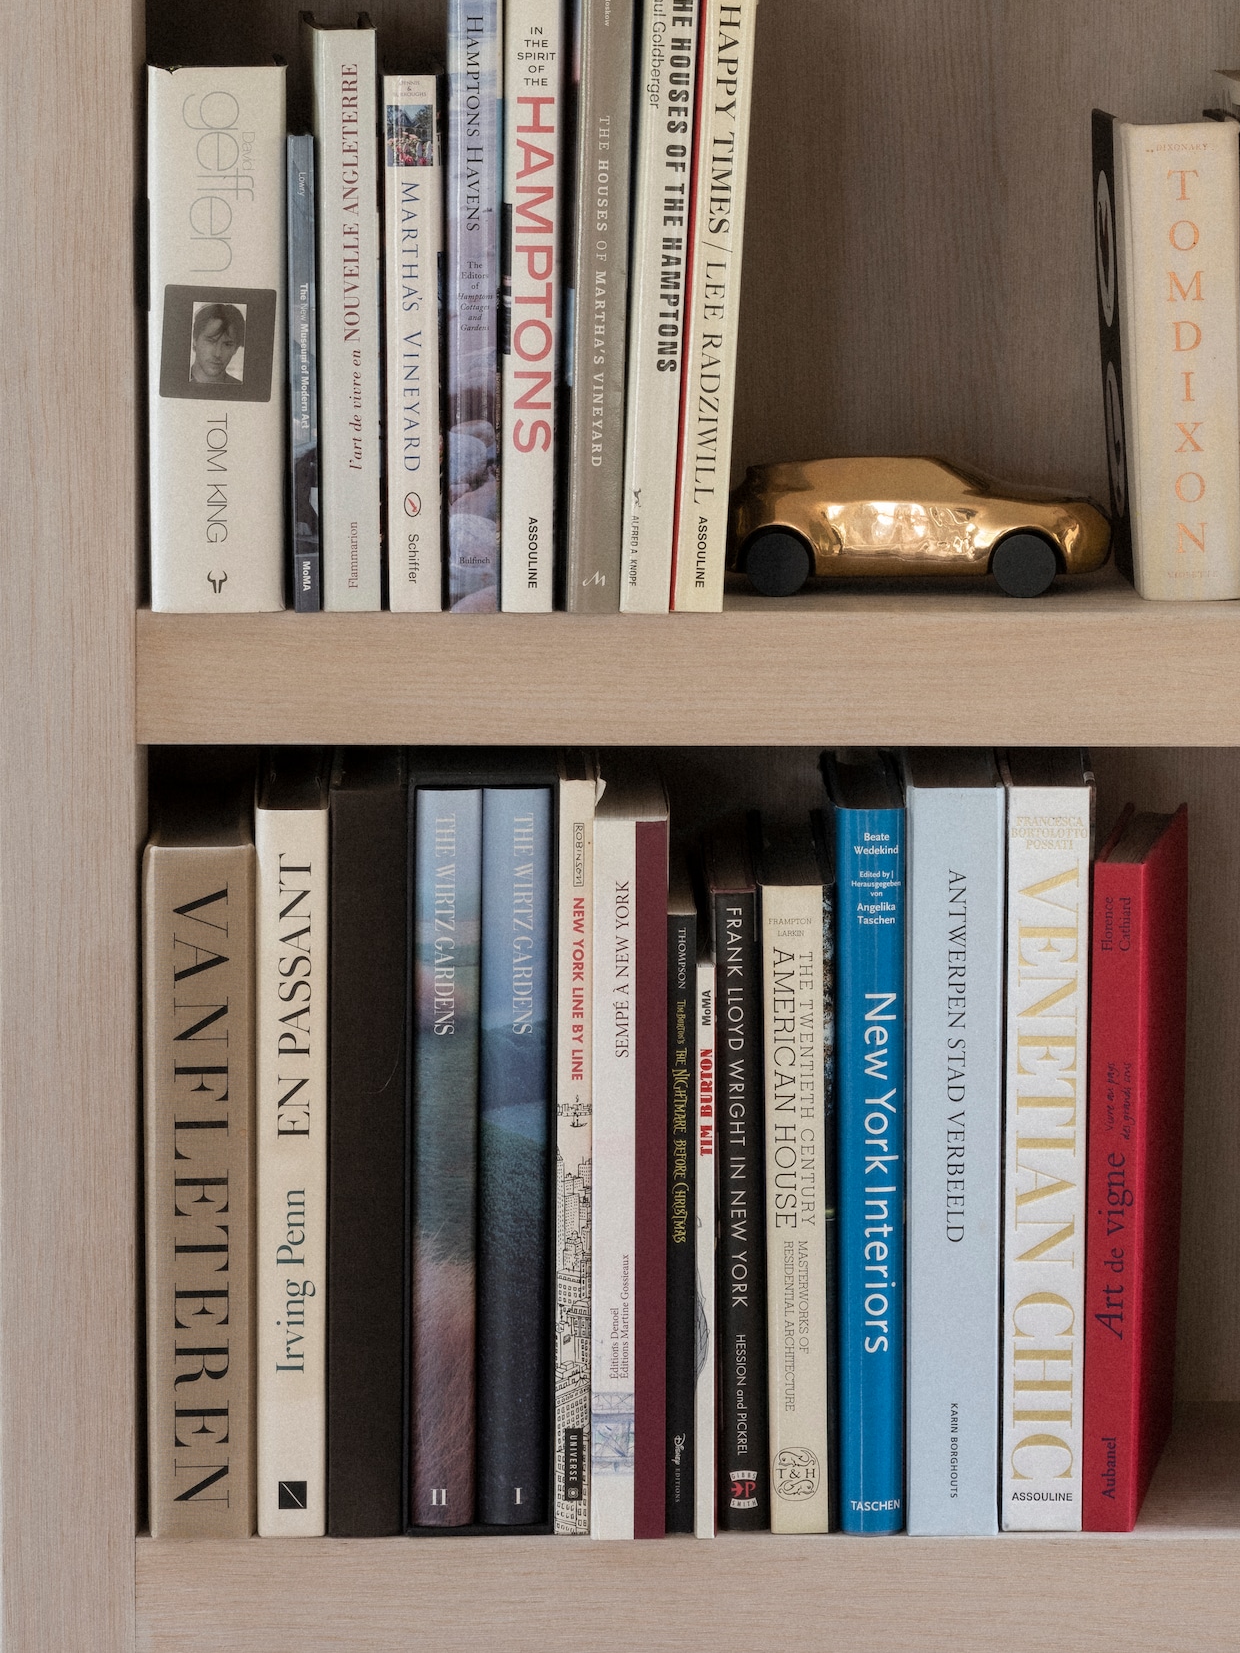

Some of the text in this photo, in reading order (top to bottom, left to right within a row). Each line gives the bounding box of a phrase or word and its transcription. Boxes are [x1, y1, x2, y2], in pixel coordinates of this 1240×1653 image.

[647, 21, 668, 109] Goldberger
[707, 4, 742, 235] HAPPY TIMES
[341, 63, 361, 343] NOUVELLE ANGLETERRE
[512, 95, 556, 454] HAMPTONS
[656, 36, 693, 373] HOUSES HAMPTONS
[401, 181, 422, 472] MARTHA'S VINEYARD
[693, 332, 724, 505] RADZIWILL
[206, 412, 228, 544] TOM KING
[302, 560, 311, 592] MoMA
[407, 533, 420, 584] Schiffer
[694, 515, 709, 589] ASSOULINE
[277, 852, 312, 1058] PASSANT
[433, 863, 457, 1036] WIRTZ GARDENS
[726, 907, 749, 1308] FRANK LLOYD WRIGHT NEW YORK
[772, 946, 798, 1229] AMERICAN HOUSE
[946, 869, 967, 1243] ANTWERPEN STAD VERBEELD
[172, 881, 230, 1508] VANFLETEREN
[863, 992, 899, 1354] New York Interiors
[1010, 858, 1080, 1481] VENETIAN CHIC
[275, 1188, 317, 1374] Irving Penn
[568, 1434, 579, 1482] UNIVERSE
[850, 1500, 901, 1511] TASCHEN
[949, 1403, 959, 1499] KARIN BORGHOUTS
[1012, 1492, 1074, 1502] ASSOULINE
